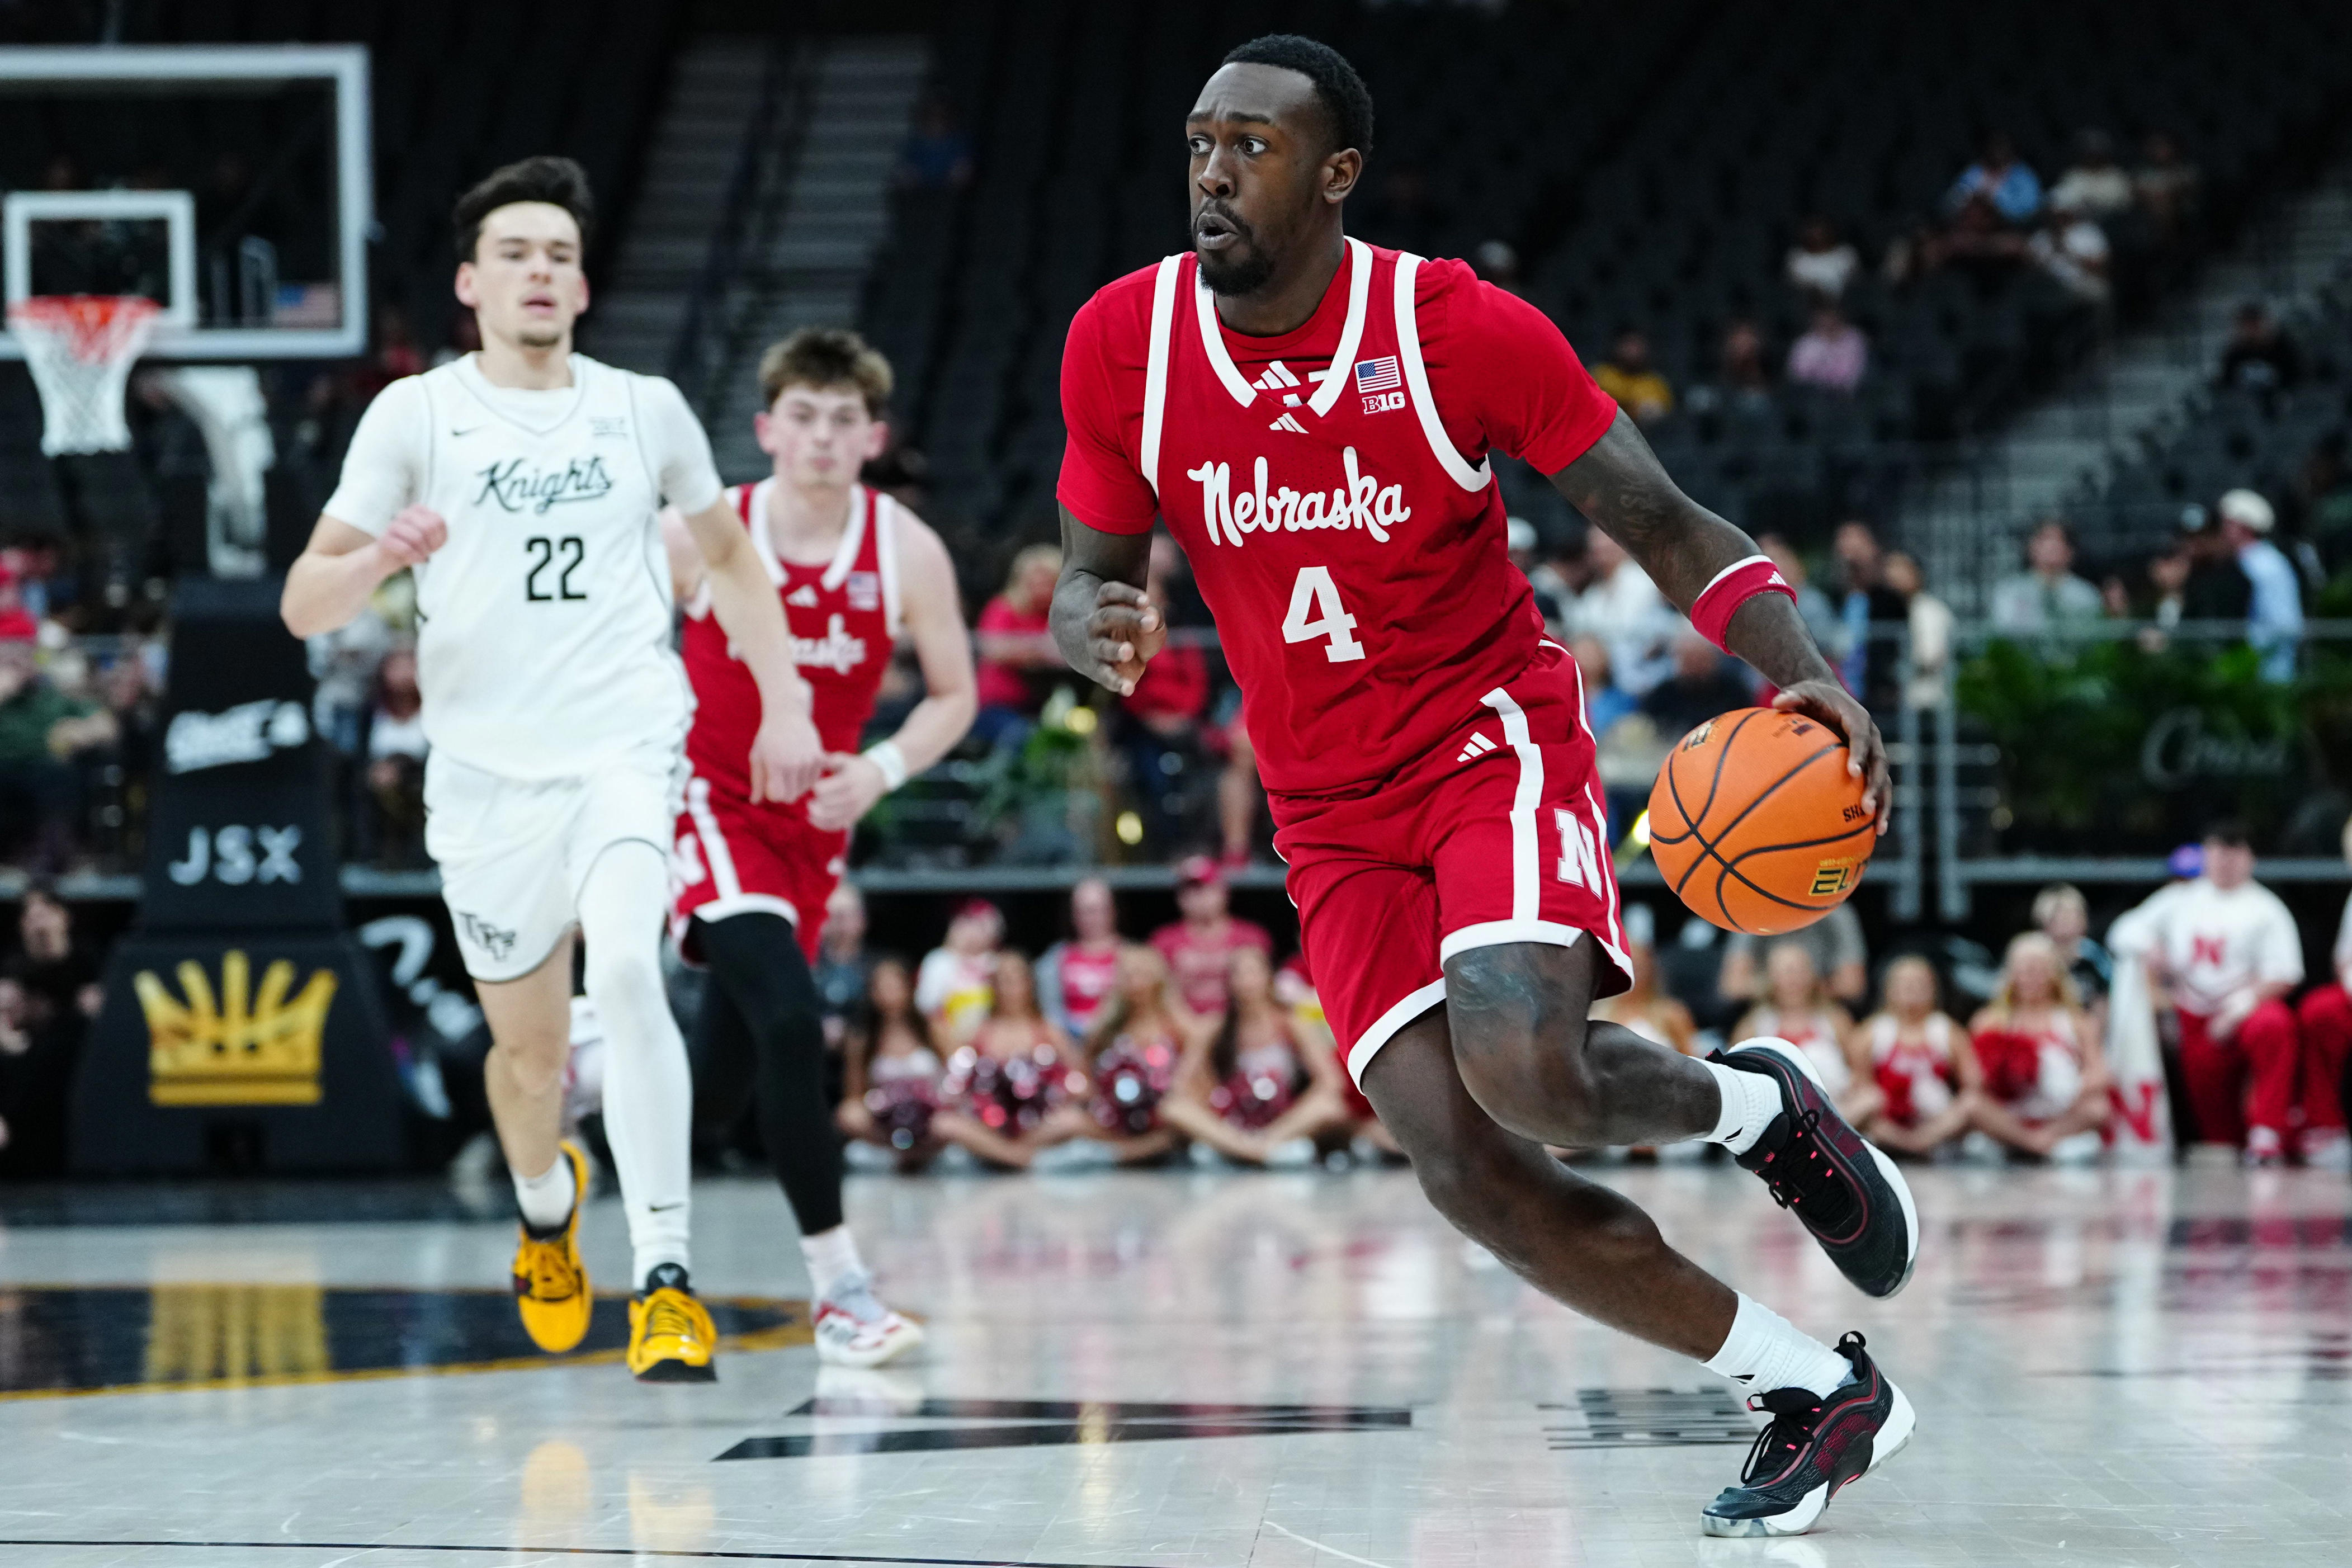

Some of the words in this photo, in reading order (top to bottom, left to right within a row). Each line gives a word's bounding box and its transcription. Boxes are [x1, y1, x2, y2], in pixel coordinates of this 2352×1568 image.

[473, 455, 614, 514] Knights
[1187, 446, 1411, 547] Nebraska
[525, 536, 587, 601] 22
[1281, 566, 1366, 663] 4
[168, 824, 304, 886] JSX
[1553, 807, 1603, 902] N
